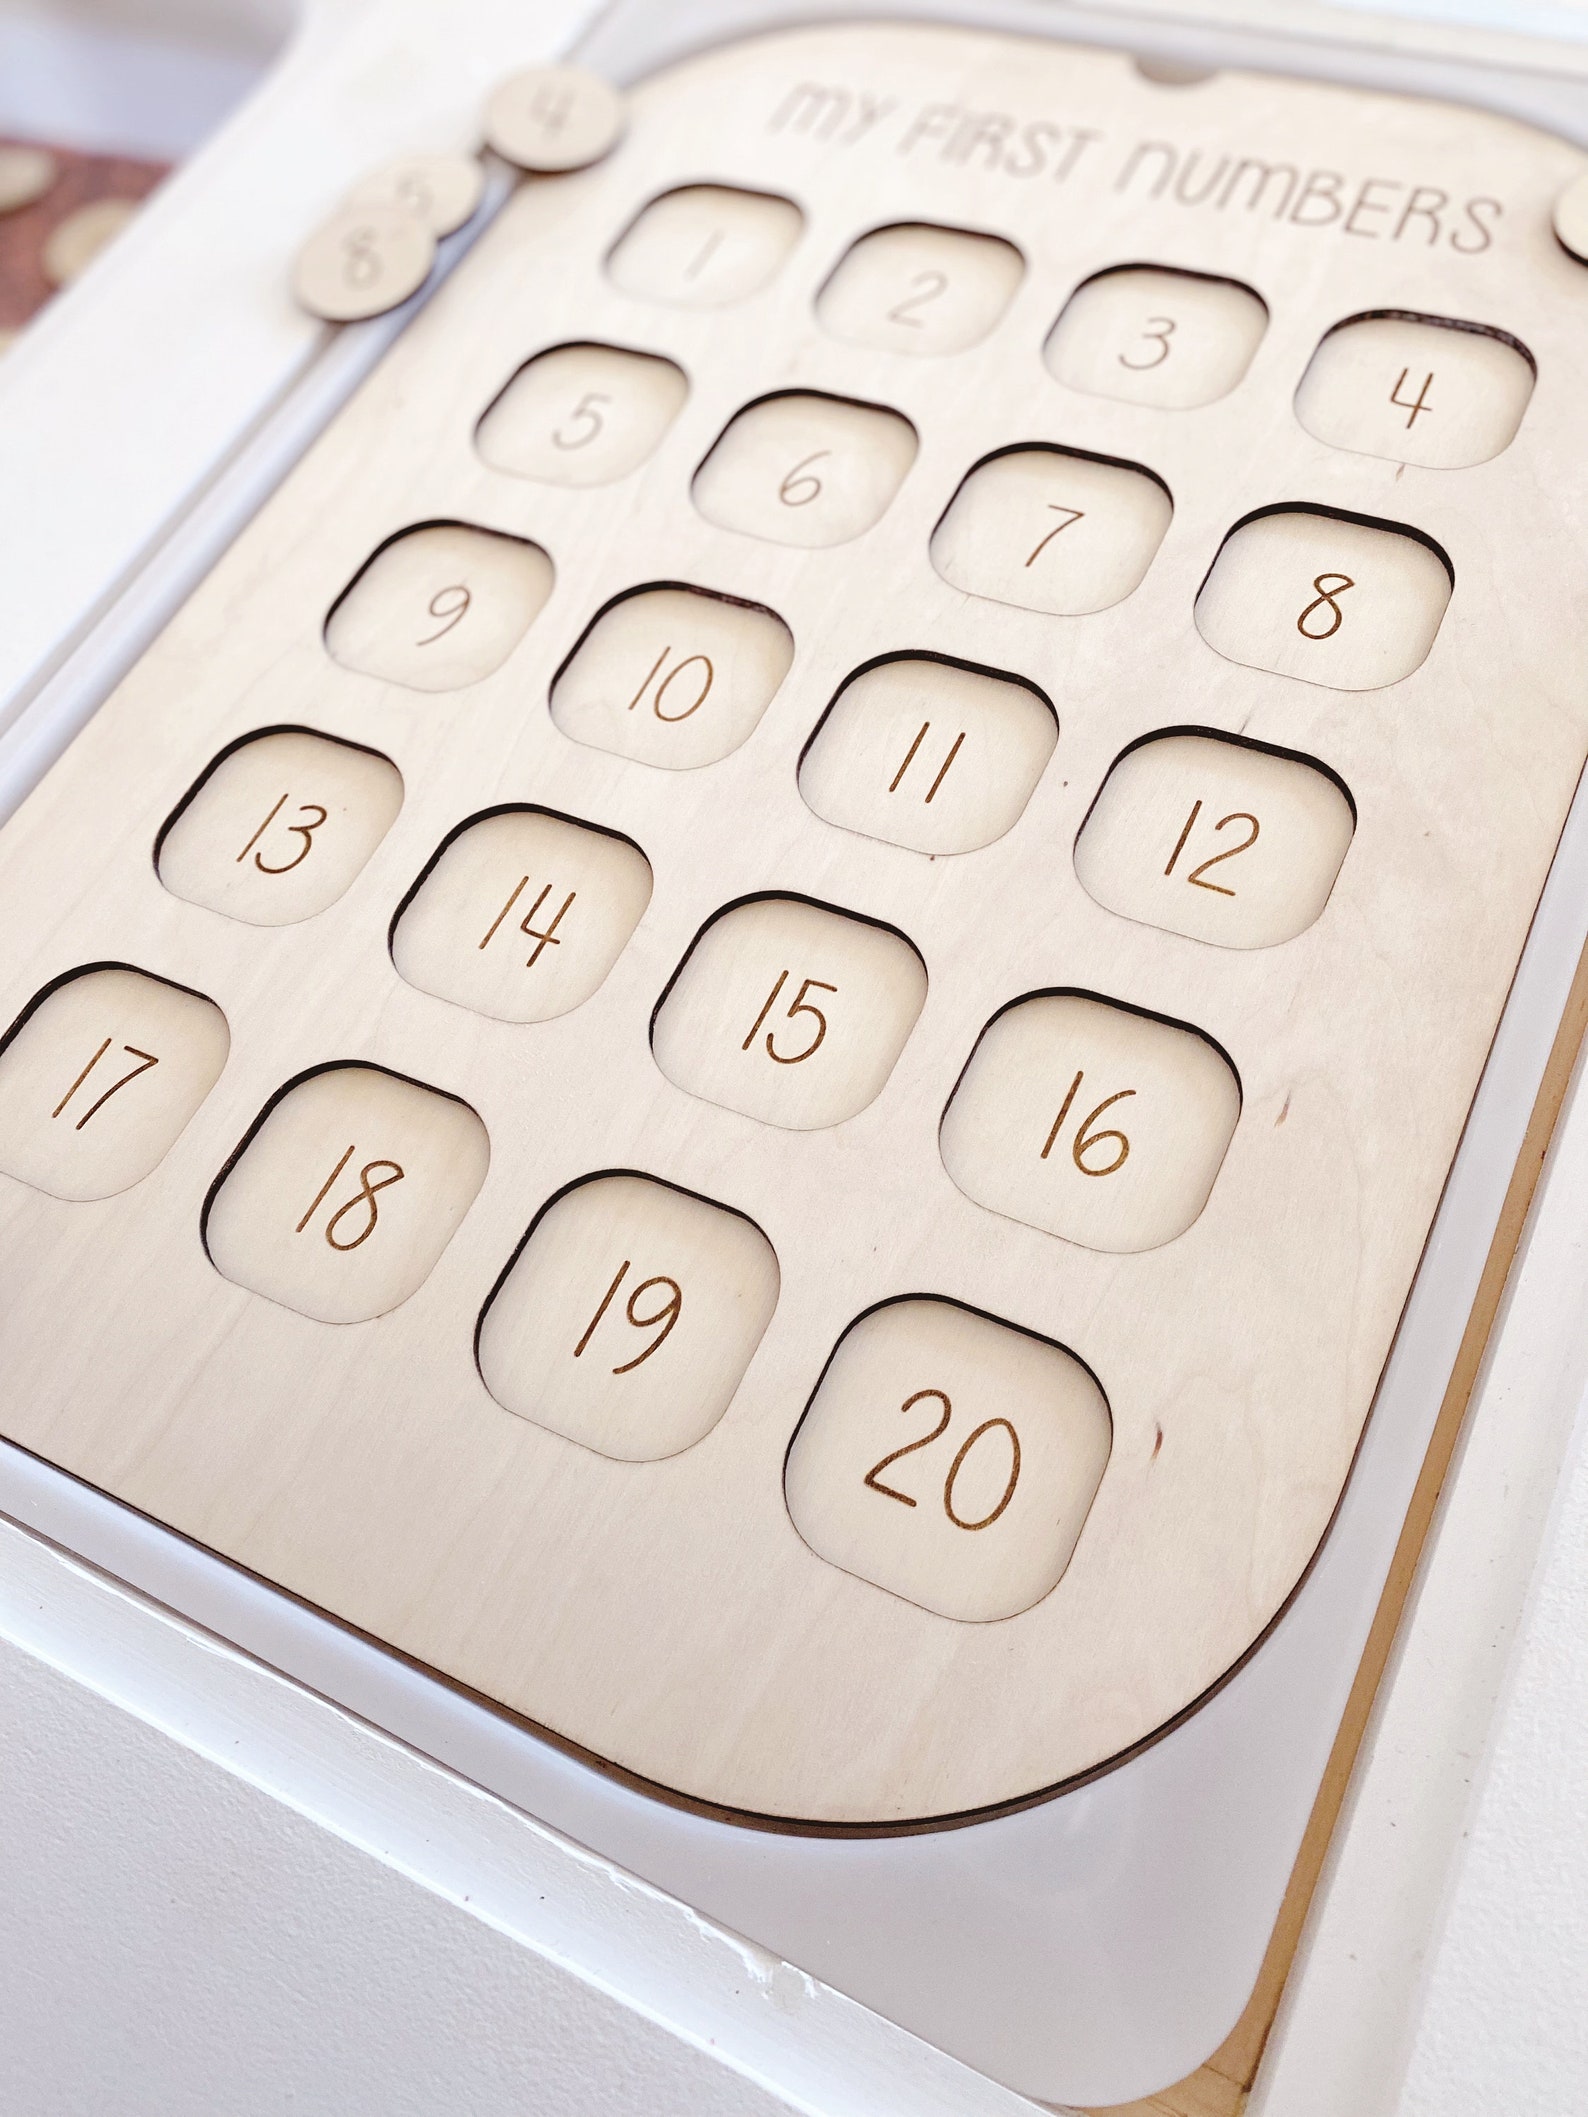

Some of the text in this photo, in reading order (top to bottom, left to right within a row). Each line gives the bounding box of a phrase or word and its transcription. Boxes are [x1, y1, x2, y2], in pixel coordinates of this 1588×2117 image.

[897, 101, 1104, 188] FIRST
[685, 227, 1435, 431] 1 2 3 4
[552, 393, 1357, 641] 5 6 7 8
[415, 582, 1261, 897] 9 10 11 12
[235, 792, 1138, 1178] 13 14 15 16
[50, 1036, 1022, 1533] 17 18 19 20
